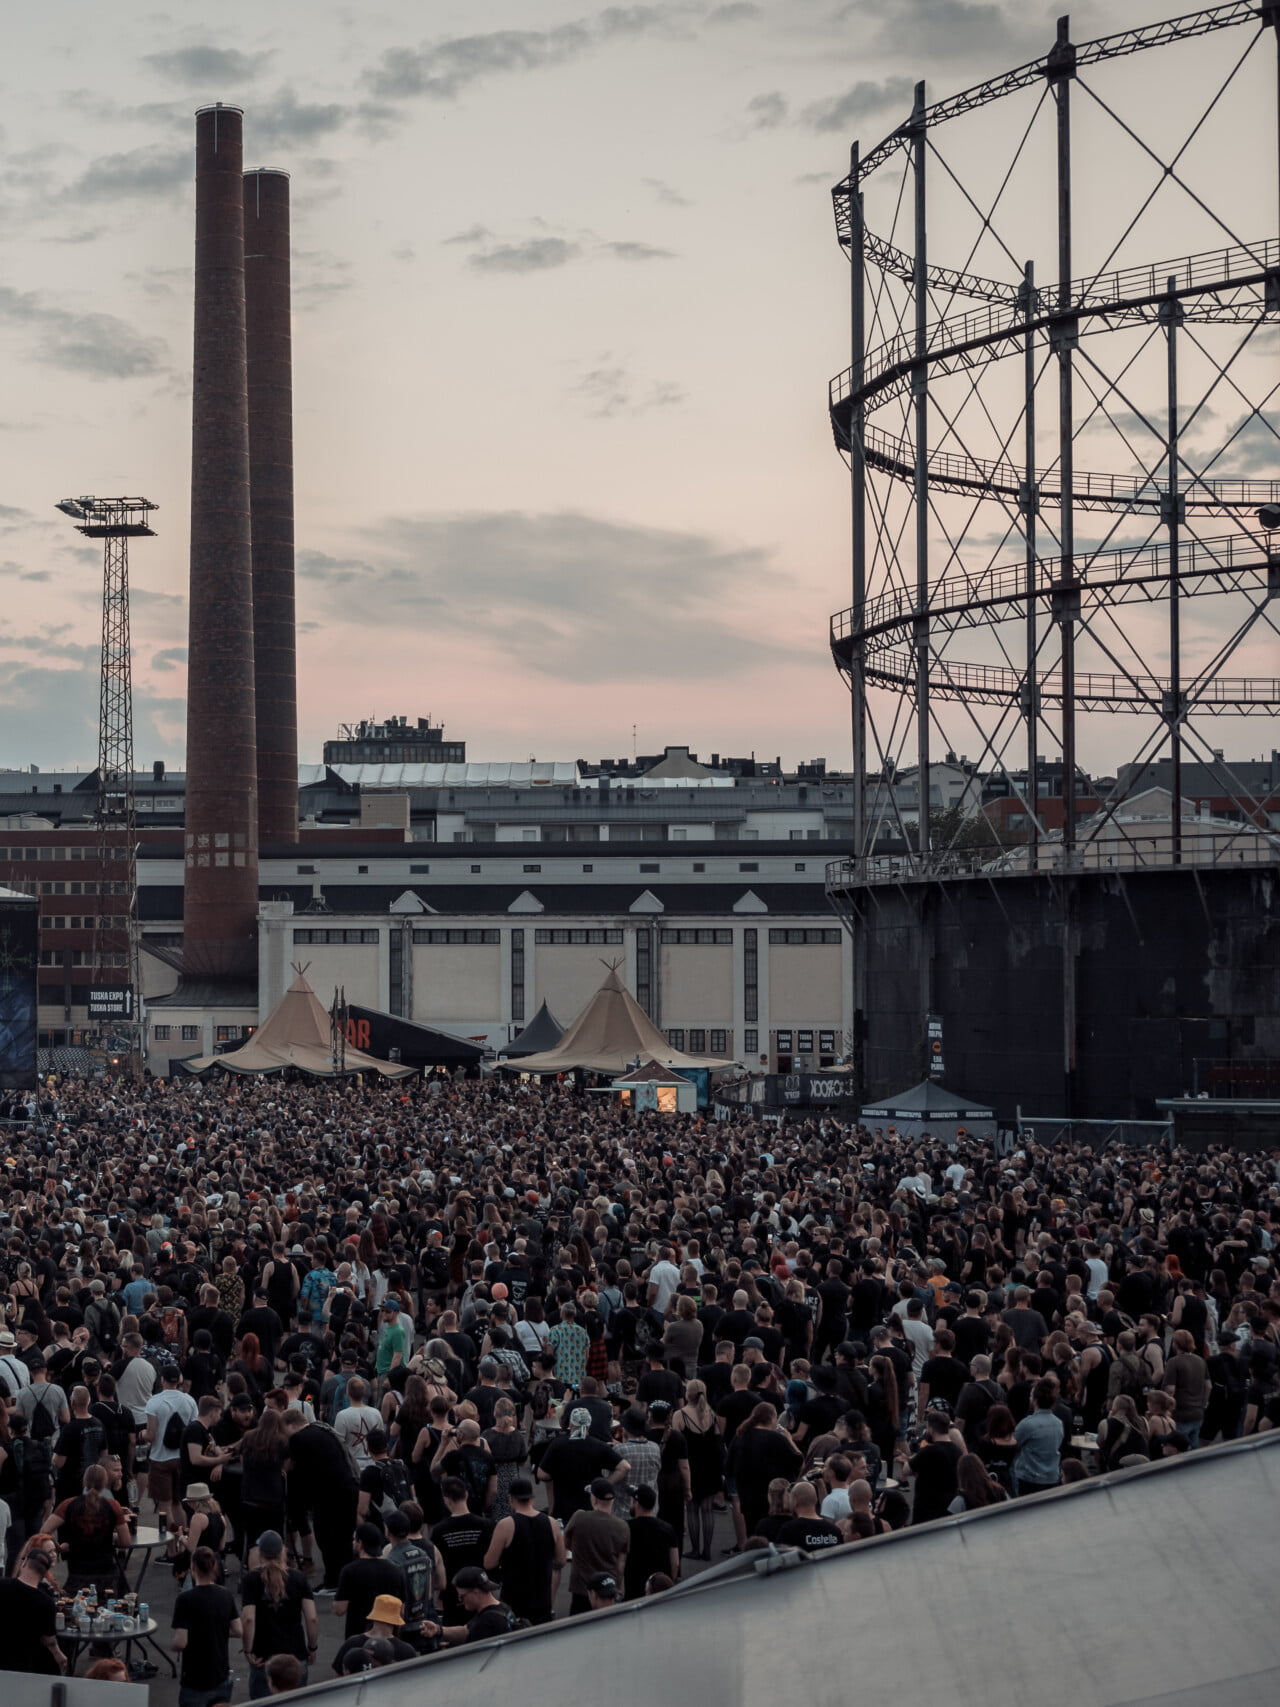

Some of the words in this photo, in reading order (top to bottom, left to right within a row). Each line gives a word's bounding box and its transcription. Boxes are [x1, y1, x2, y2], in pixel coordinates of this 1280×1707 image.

[90, 991, 108, 1001] TUSKA
[109, 991, 124, 1001] EXPO
[90, 1003, 107, 1012] TUSKA
[107, 1003, 123, 1012] STORE
